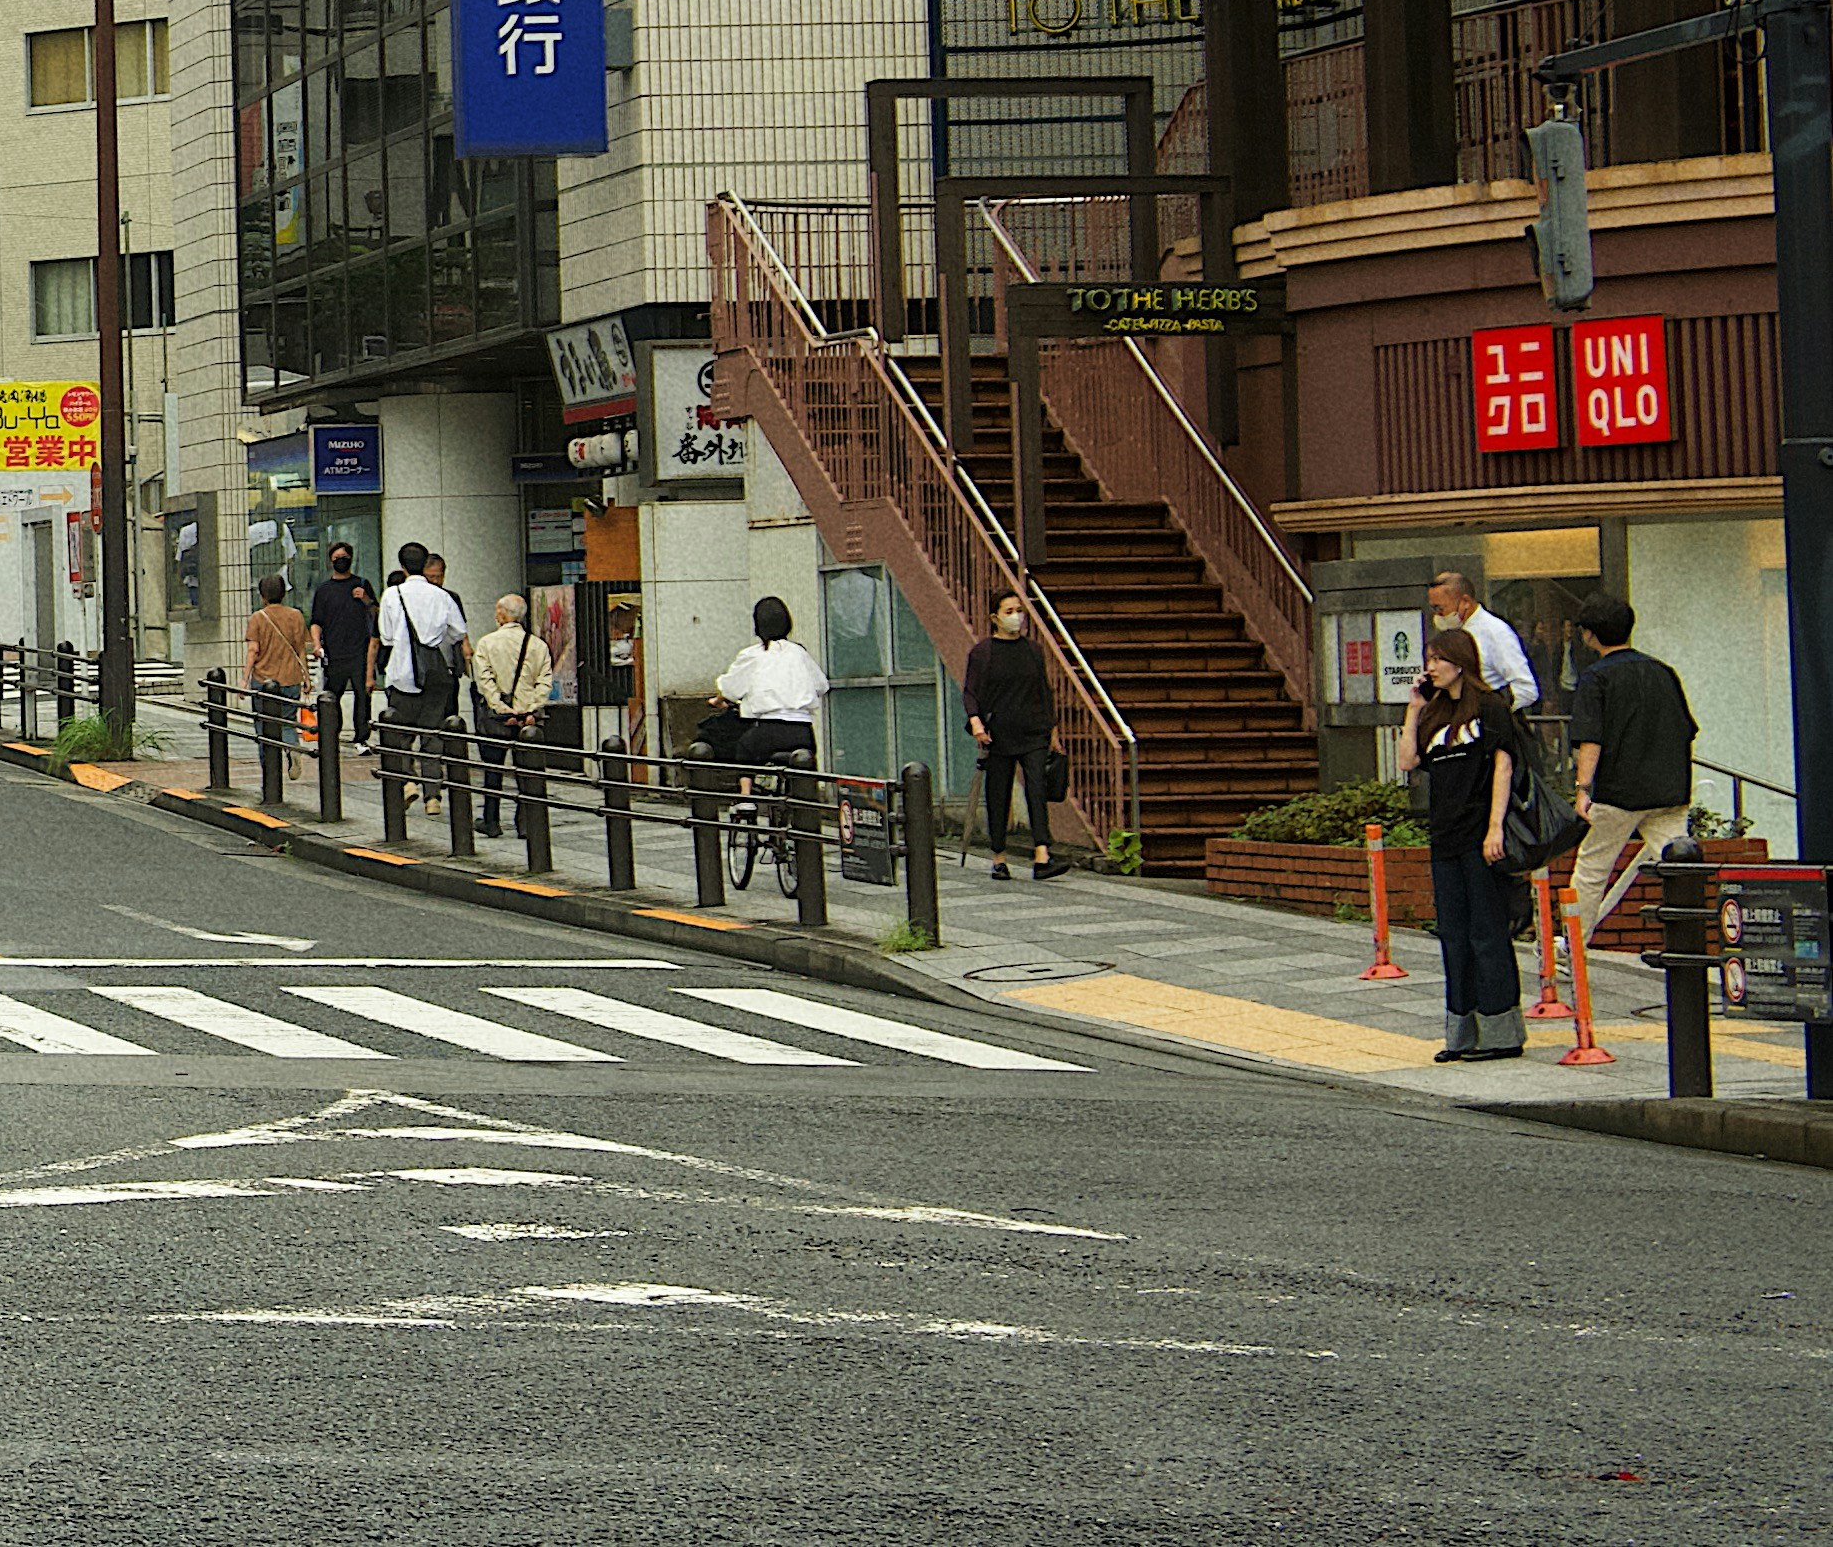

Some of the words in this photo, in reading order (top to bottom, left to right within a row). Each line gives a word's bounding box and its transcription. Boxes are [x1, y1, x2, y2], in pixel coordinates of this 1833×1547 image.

[1067, 288, 1112, 311] TO
[1113, 287, 1166, 311] THE
[1486, 341, 1545, 384] ユニ
[1585, 332, 1651, 379] UNI
[1487, 392, 1547, 435] クロ
[1587, 384, 1659, 437] QLO
[3, 434, 98, 467] 営業中
[327, 440, 365, 450] MIZUHO
[324, 465, 371, 475] ATMコーナー
[335, 457, 358, 466] みずほ
[1384, 665, 1422, 676] STARBUCKS
[1391, 676, 1415, 686] COFFEE
